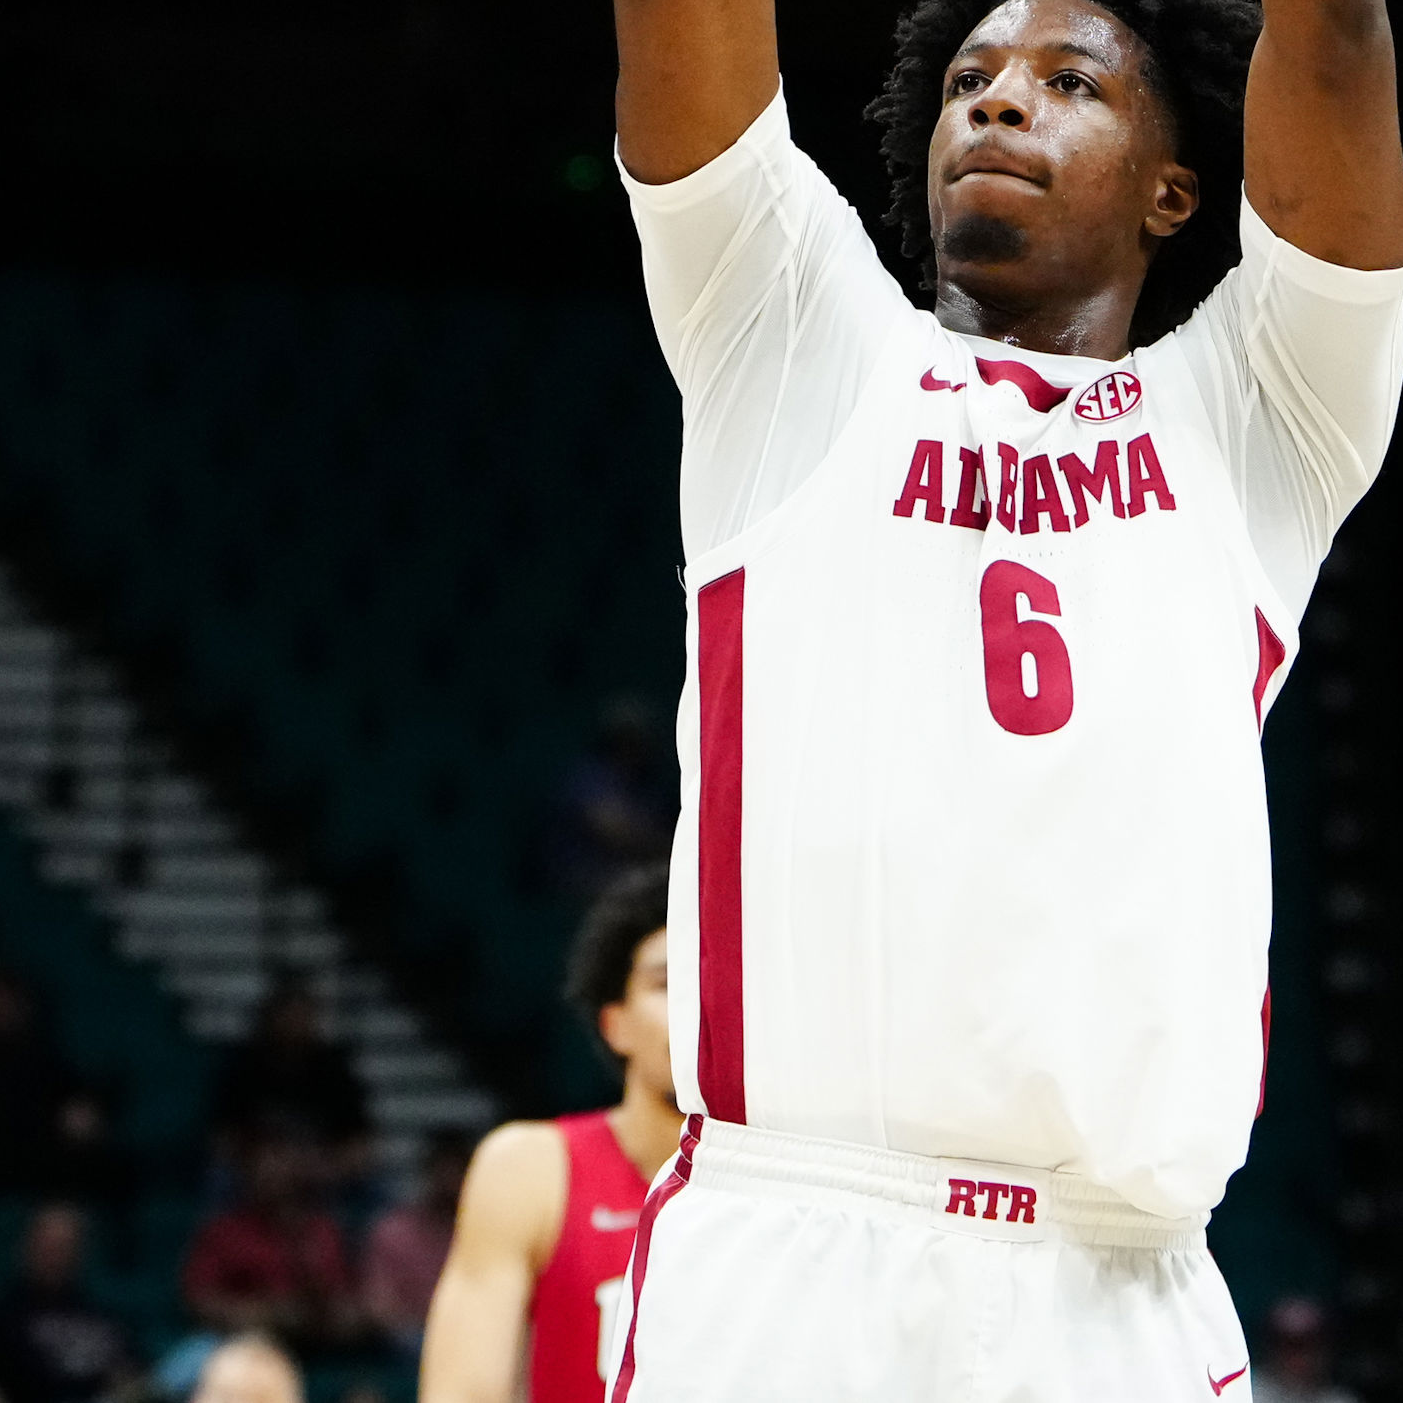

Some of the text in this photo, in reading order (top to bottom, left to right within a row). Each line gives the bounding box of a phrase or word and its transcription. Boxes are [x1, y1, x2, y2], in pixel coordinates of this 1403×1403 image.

[1078, 372, 1139, 419] SEC
[892, 432, 1177, 536] ALBAMA
[979, 559, 1074, 736] 6
[944, 1178, 1037, 1224] RTR
